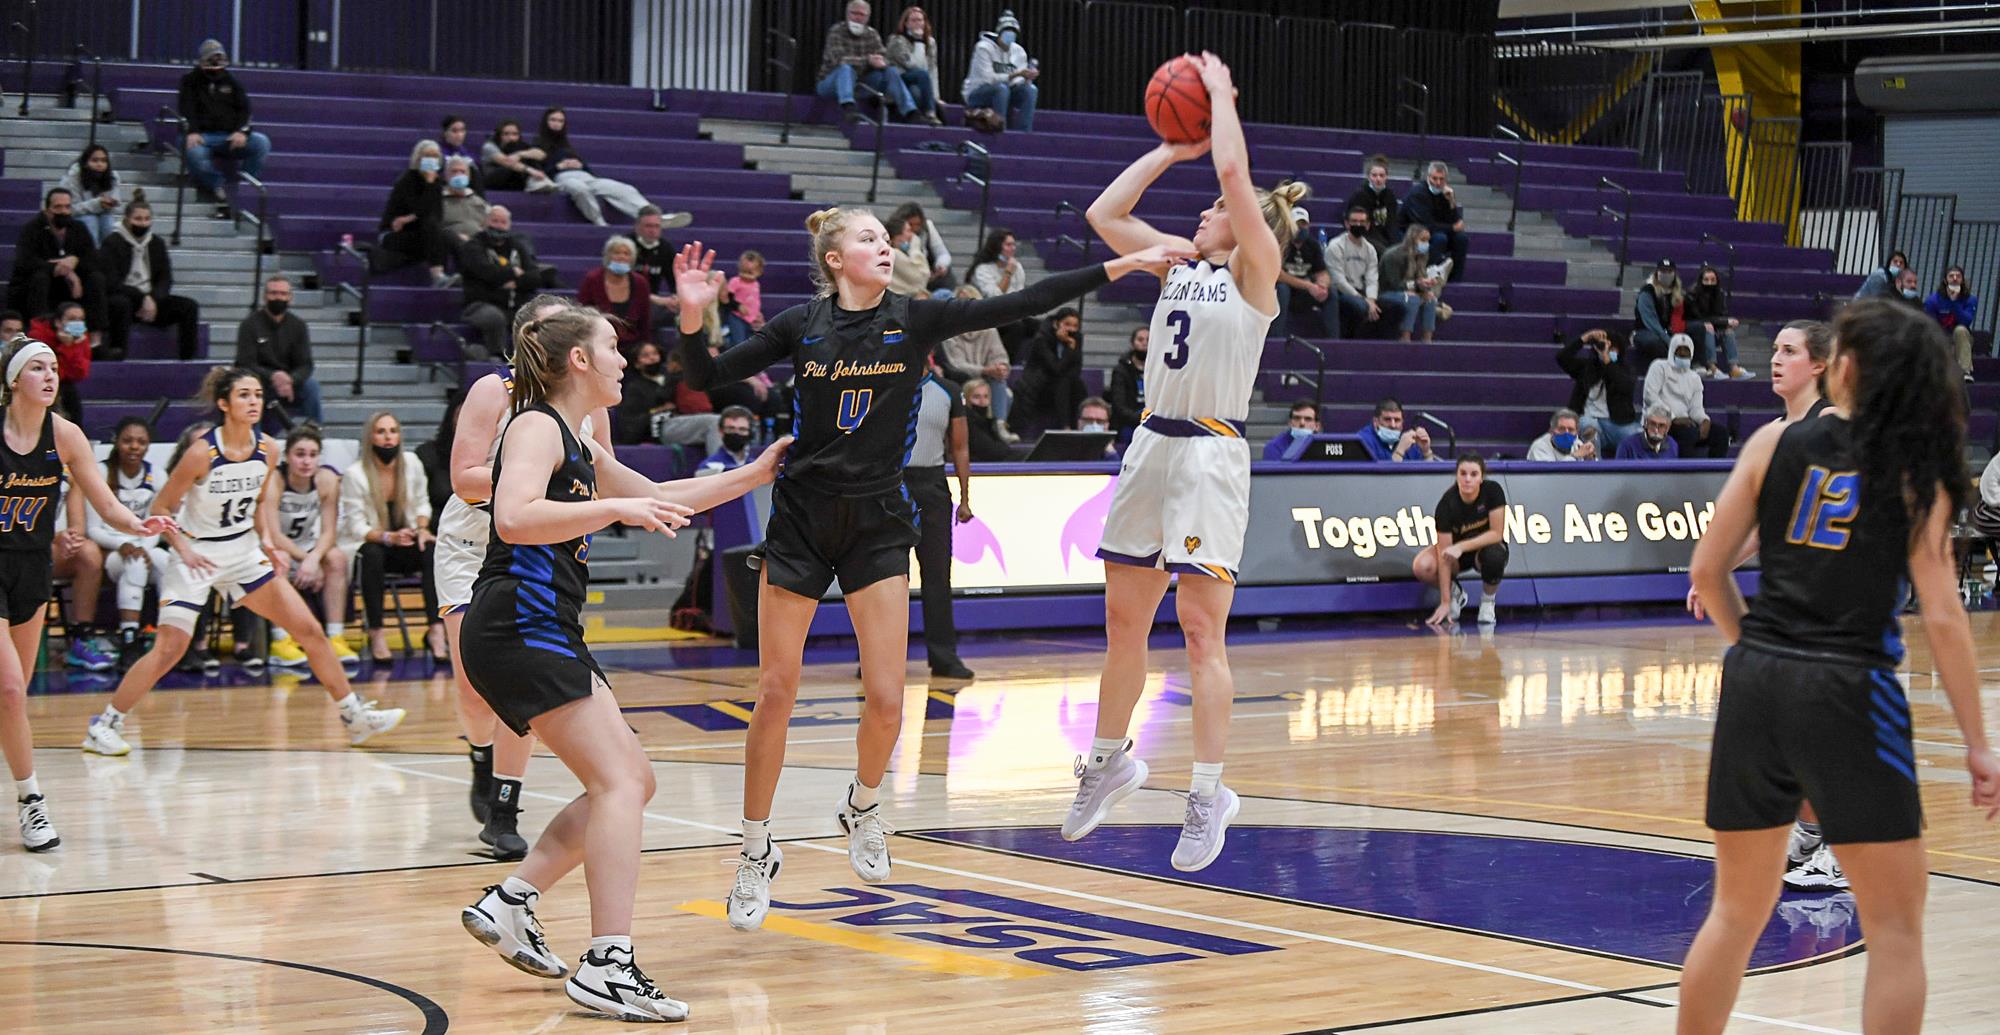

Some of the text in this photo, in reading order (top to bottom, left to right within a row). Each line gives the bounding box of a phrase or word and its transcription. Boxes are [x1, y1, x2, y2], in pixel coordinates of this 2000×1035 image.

[1190, 281, 1228, 302] RAMS
[1163, 309, 1192, 370] 3
[802, 359, 906, 381] Pitt Johnstown
[1325, 443, 1343, 456] POSS
[209, 478, 244, 494] GOLDEN
[0, 495, 48, 533] 44
[219, 496, 254, 528] 13
[1785, 464, 1861, 551] 12
[287, 516, 308, 539] 5
[1291, 504, 1438, 558] Togeth
[1563, 502, 1629, 543] Are
